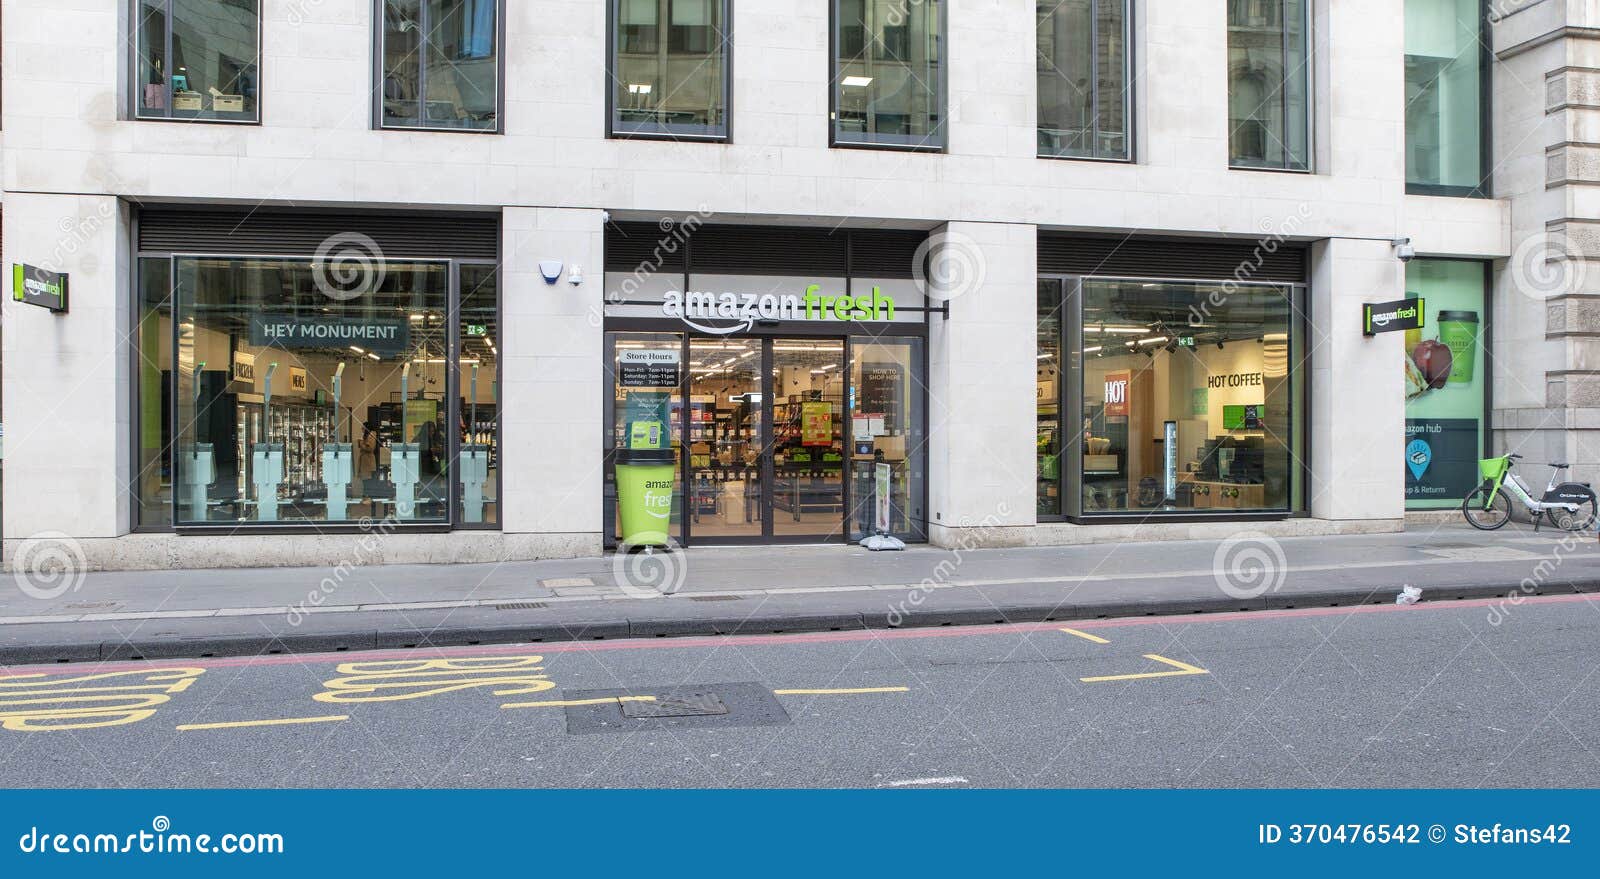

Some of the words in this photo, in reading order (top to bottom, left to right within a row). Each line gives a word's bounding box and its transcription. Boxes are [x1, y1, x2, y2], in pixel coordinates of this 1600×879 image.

[264, 324, 297, 337] HEY
[301, 325, 398, 339] MONUMENT
[626, 352, 648, 360] Store
[649, 352, 673, 360] Hours
[1208, 375, 1226, 388] HOT
[1228, 373, 1261, 387] COFFEE
[1105, 380, 1127, 403] HOT
[1406, 424, 1424, 433] azon
[1426, 423, 1442, 433] hub
